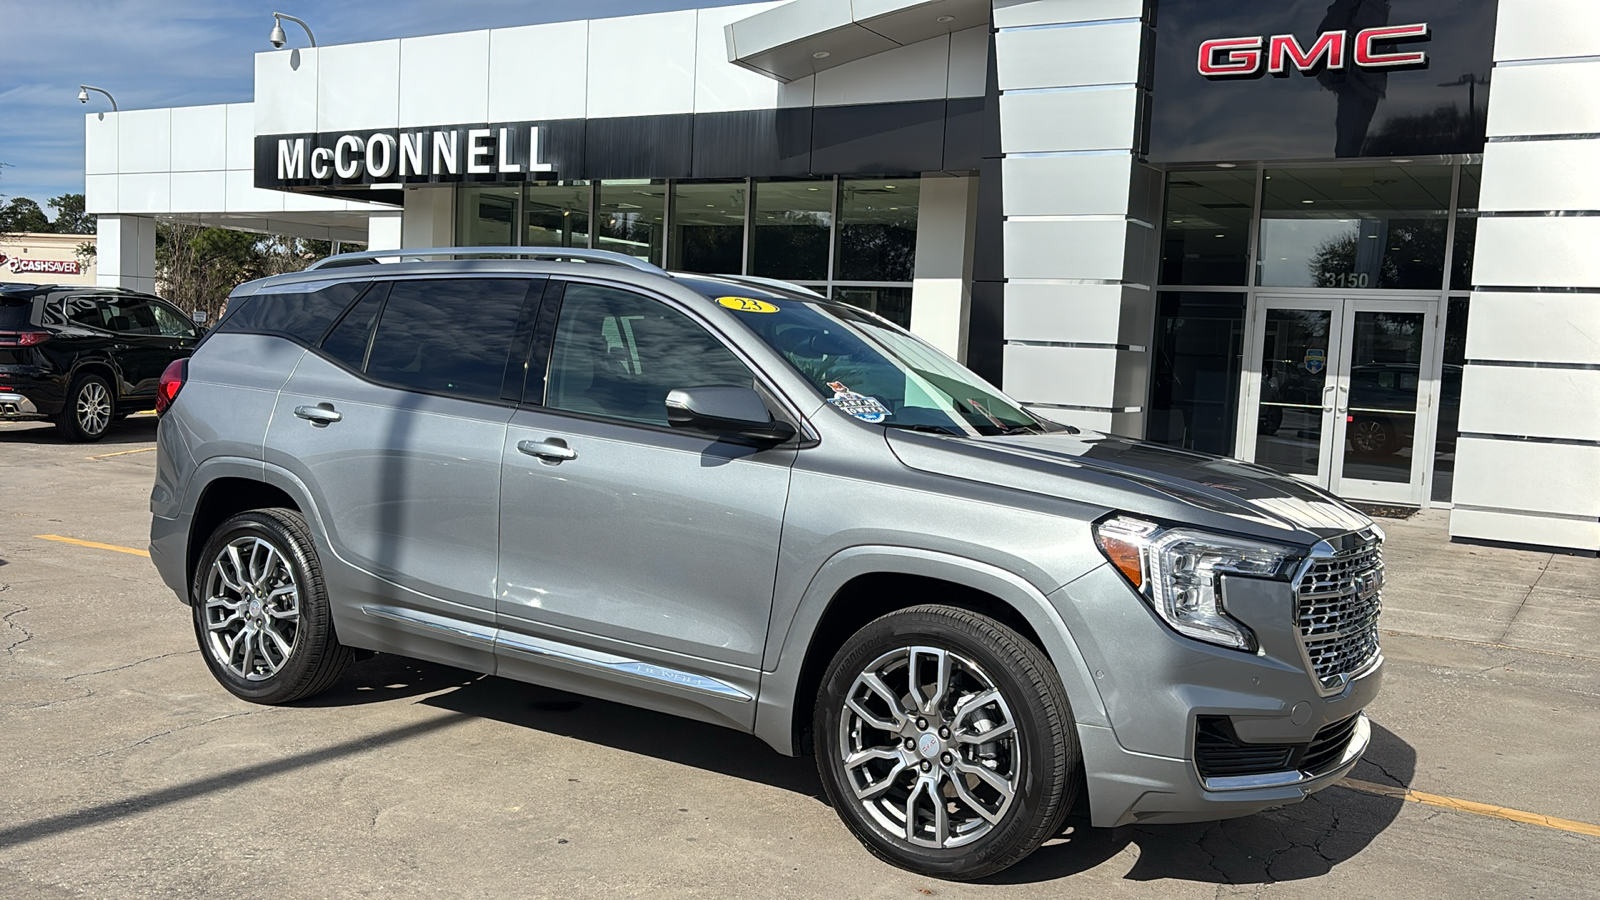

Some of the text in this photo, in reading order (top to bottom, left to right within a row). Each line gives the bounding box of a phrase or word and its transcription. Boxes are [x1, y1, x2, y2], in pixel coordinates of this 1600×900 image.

[1198, 23, 1427, 76] GMC
[278, 126, 552, 180] McCONNELL
[1326, 272, 1369, 288] 3150
[734, 298, 762, 311] 23
